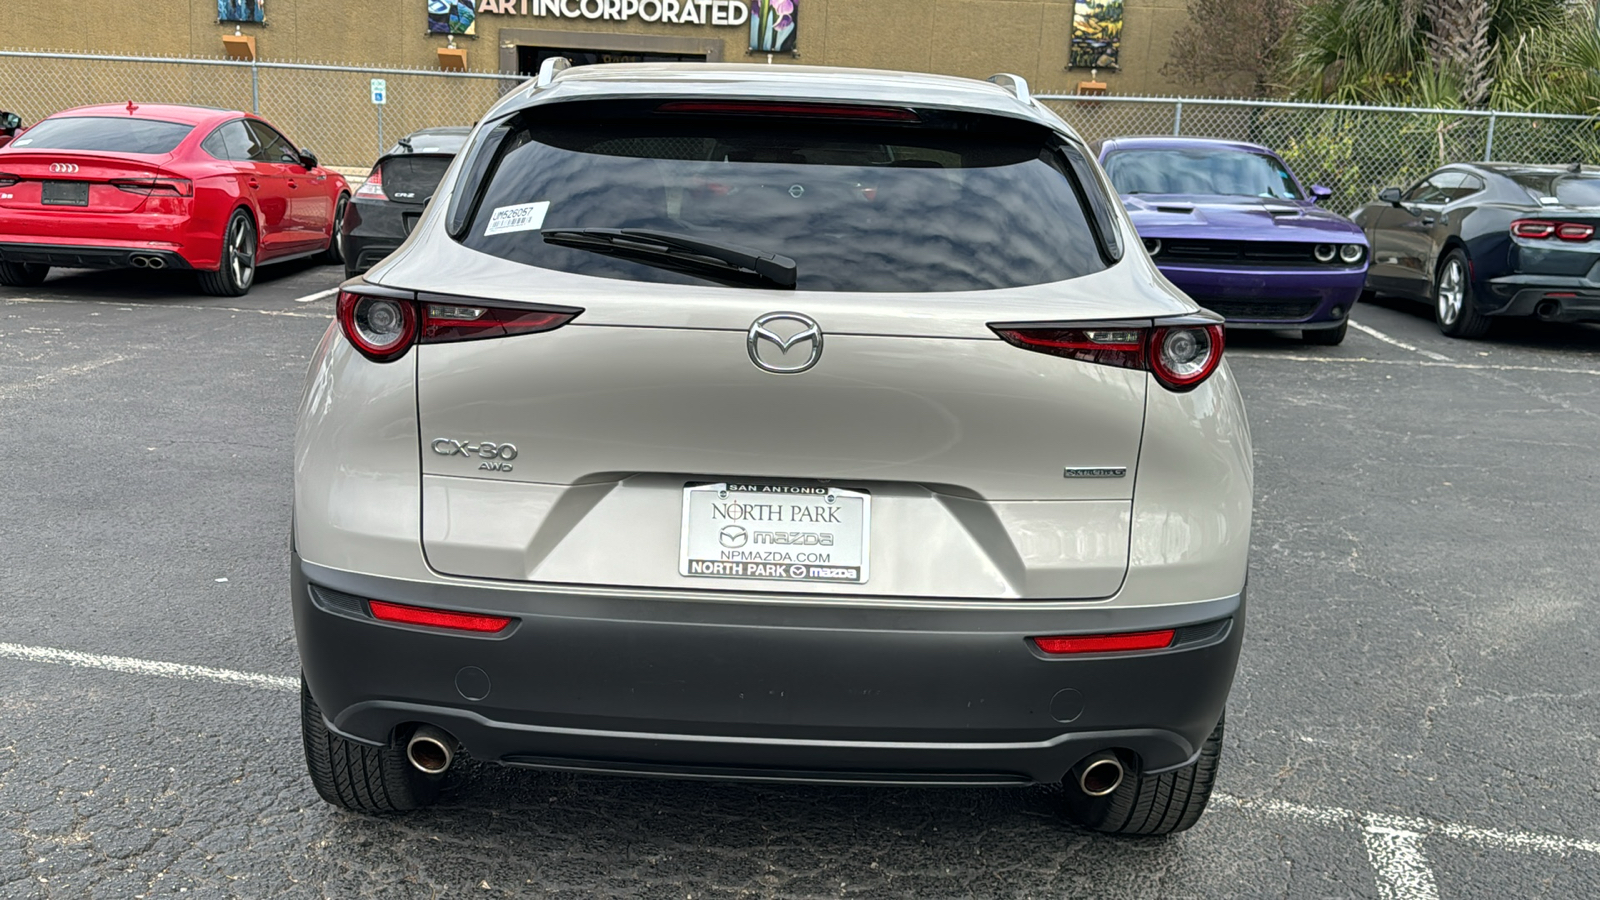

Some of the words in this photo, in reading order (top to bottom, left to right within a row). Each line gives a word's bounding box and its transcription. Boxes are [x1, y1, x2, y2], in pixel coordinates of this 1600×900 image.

[431, 437, 518, 461] CX-30
[478, 461, 513, 473] AWD
[729, 484, 757, 492] SAN
[762, 486, 826, 494] ANTONIO
[711, 502, 783, 521] NORTH
[790, 505, 841, 523] PARK
[720, 550, 831, 563] NPMAZDA.COM
[691, 561, 743, 575] NORTH
[747, 564, 787, 577] PARK
